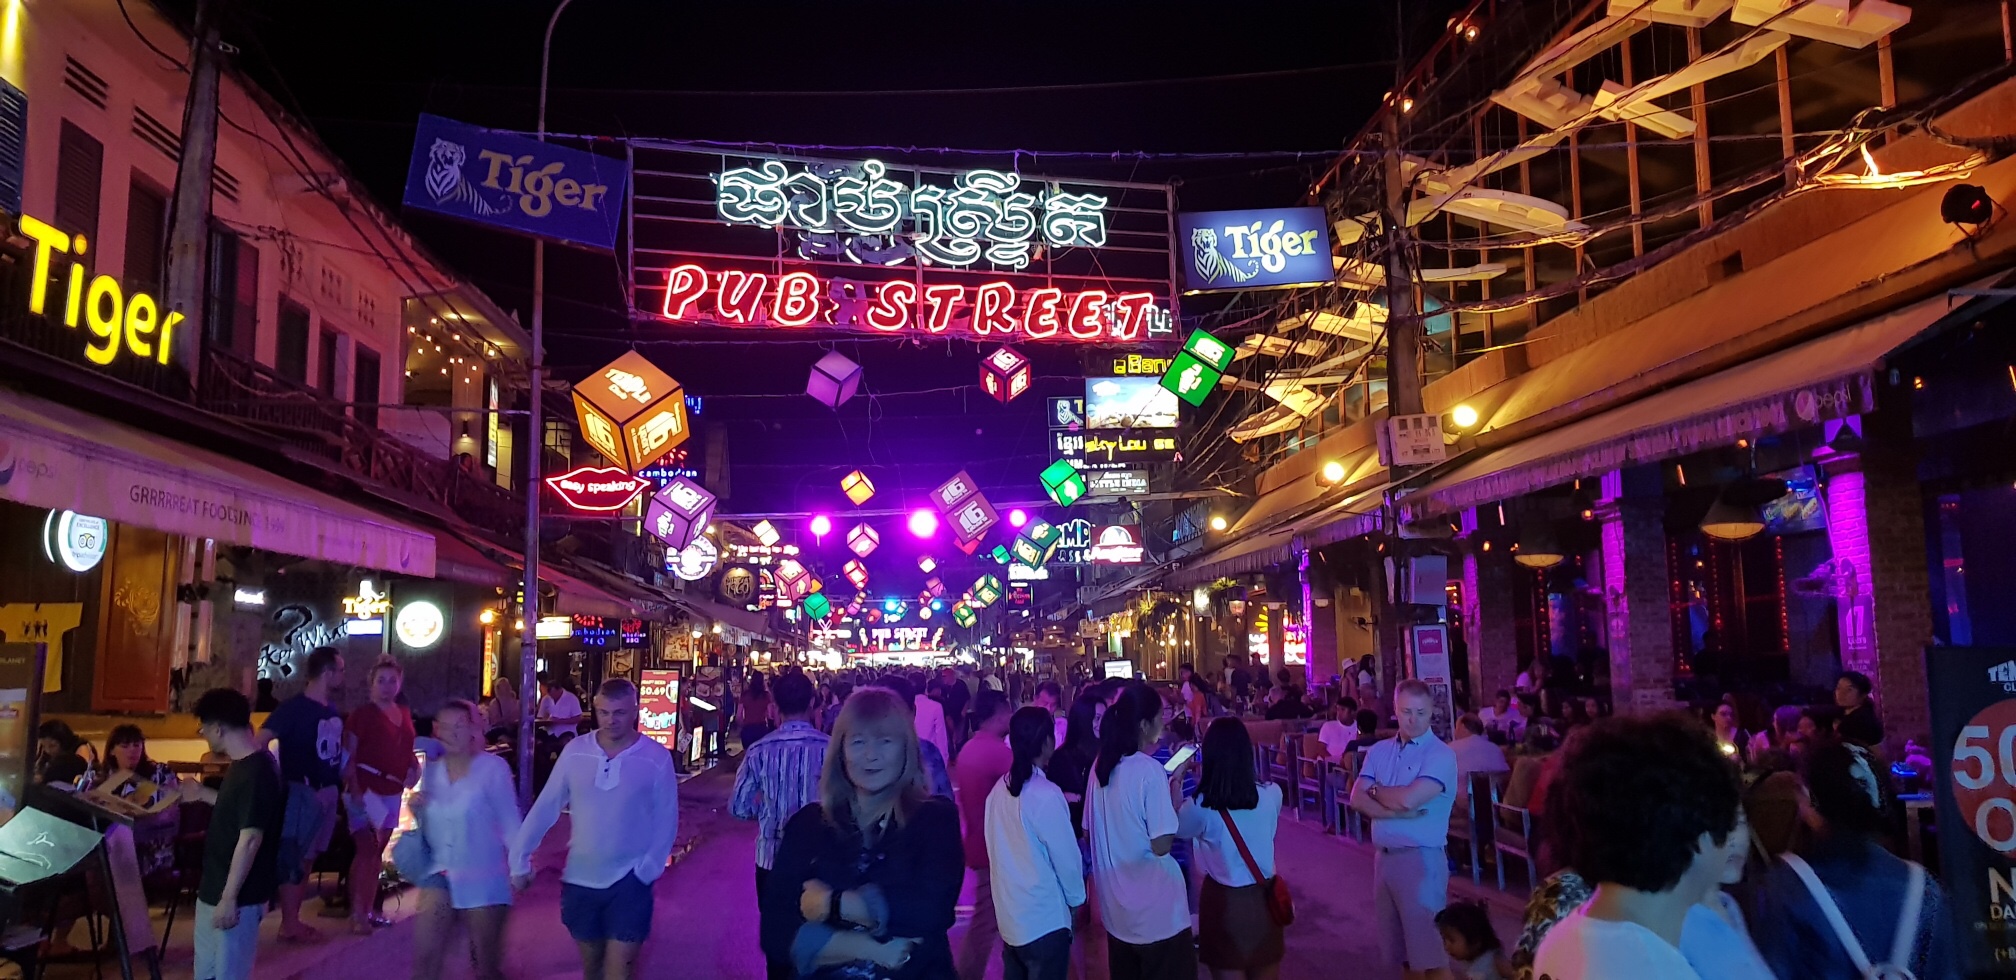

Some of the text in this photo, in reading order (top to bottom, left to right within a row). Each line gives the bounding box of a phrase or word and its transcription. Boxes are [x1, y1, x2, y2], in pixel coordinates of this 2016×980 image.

[478, 149, 608, 218] Tiger
[1224, 219, 1318, 273] Tiger
[19, 213, 186, 366] Tiger
[663, 265, 820, 326] PUB
[867, 280, 1153, 341] STREET
[342, 596, 392, 620] Tiger
[640, 686, 666, 696] $0.69
